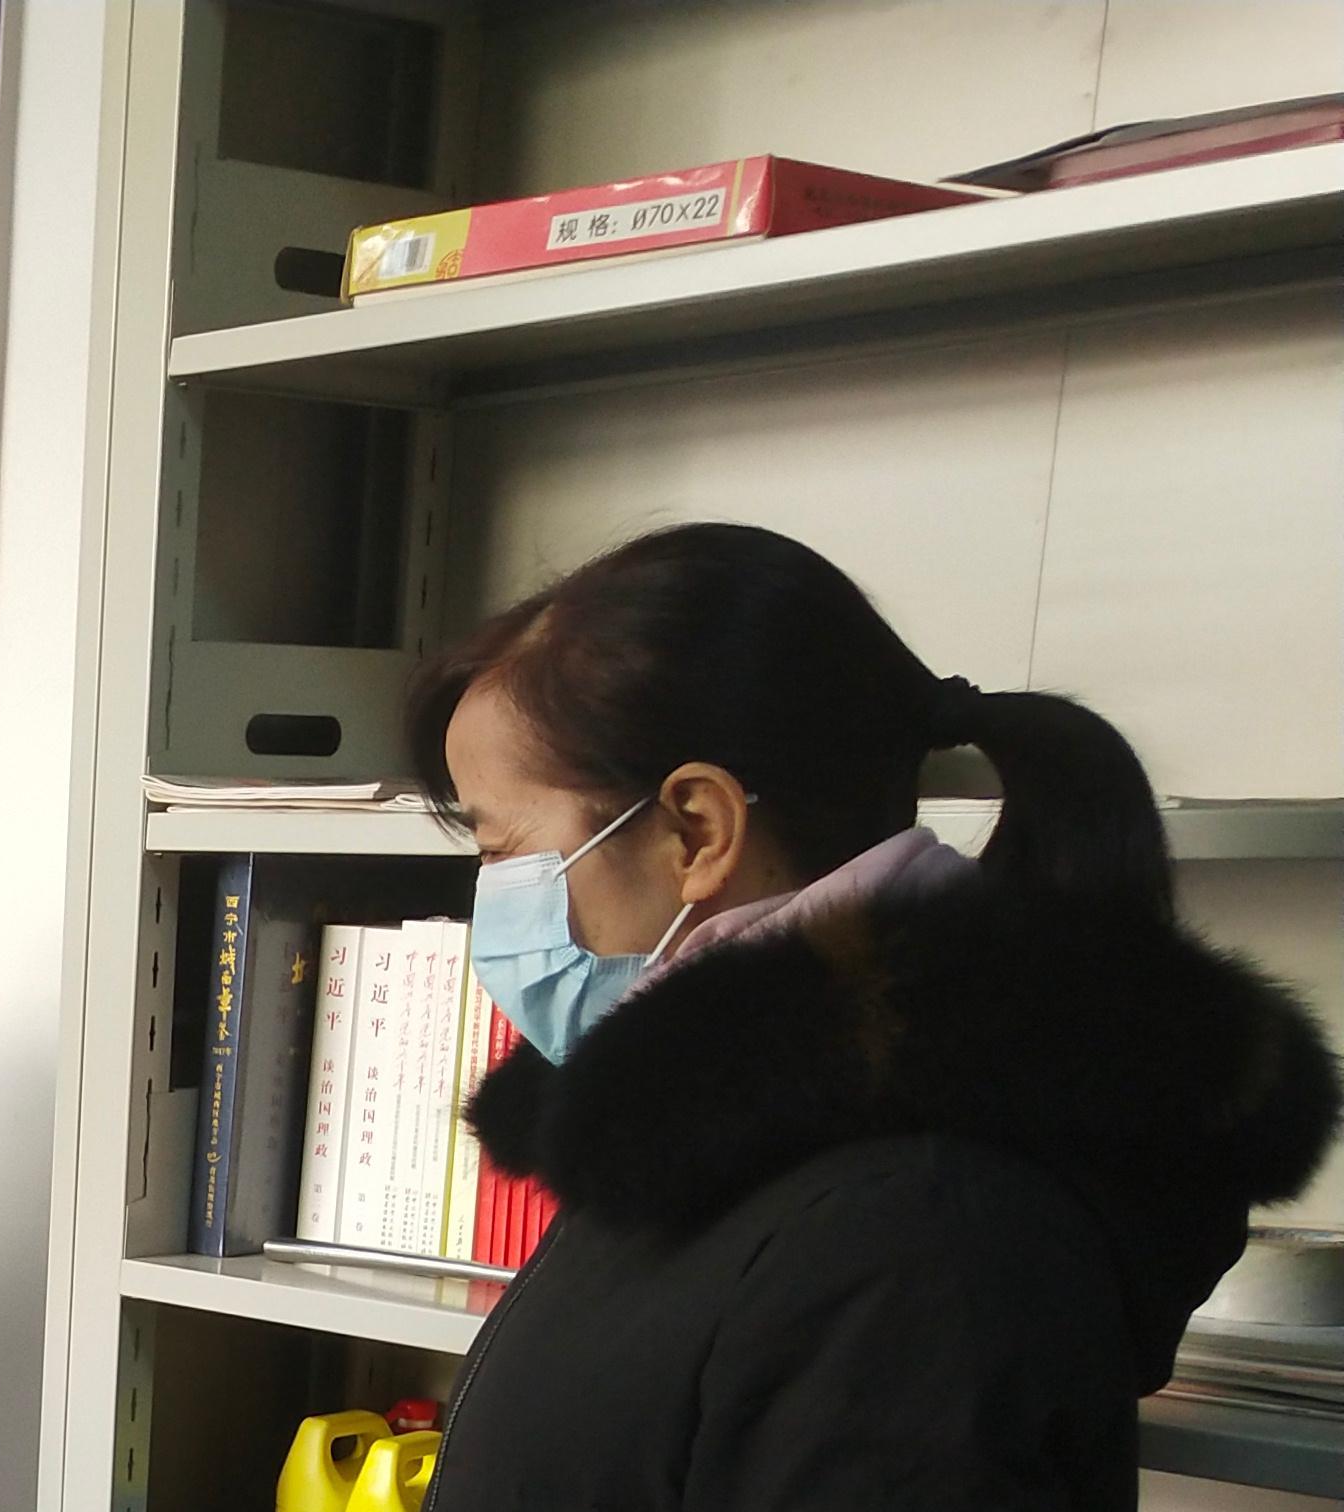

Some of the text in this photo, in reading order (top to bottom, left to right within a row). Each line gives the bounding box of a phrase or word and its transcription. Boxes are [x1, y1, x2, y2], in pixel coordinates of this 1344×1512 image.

[325, 946, 347, 1032] 习近平
[370, 952, 391, 1038] 习近平
[314, 1058, 335, 1159] 谈治国理政
[358, 1066, 379, 1167] 谈治国理政
